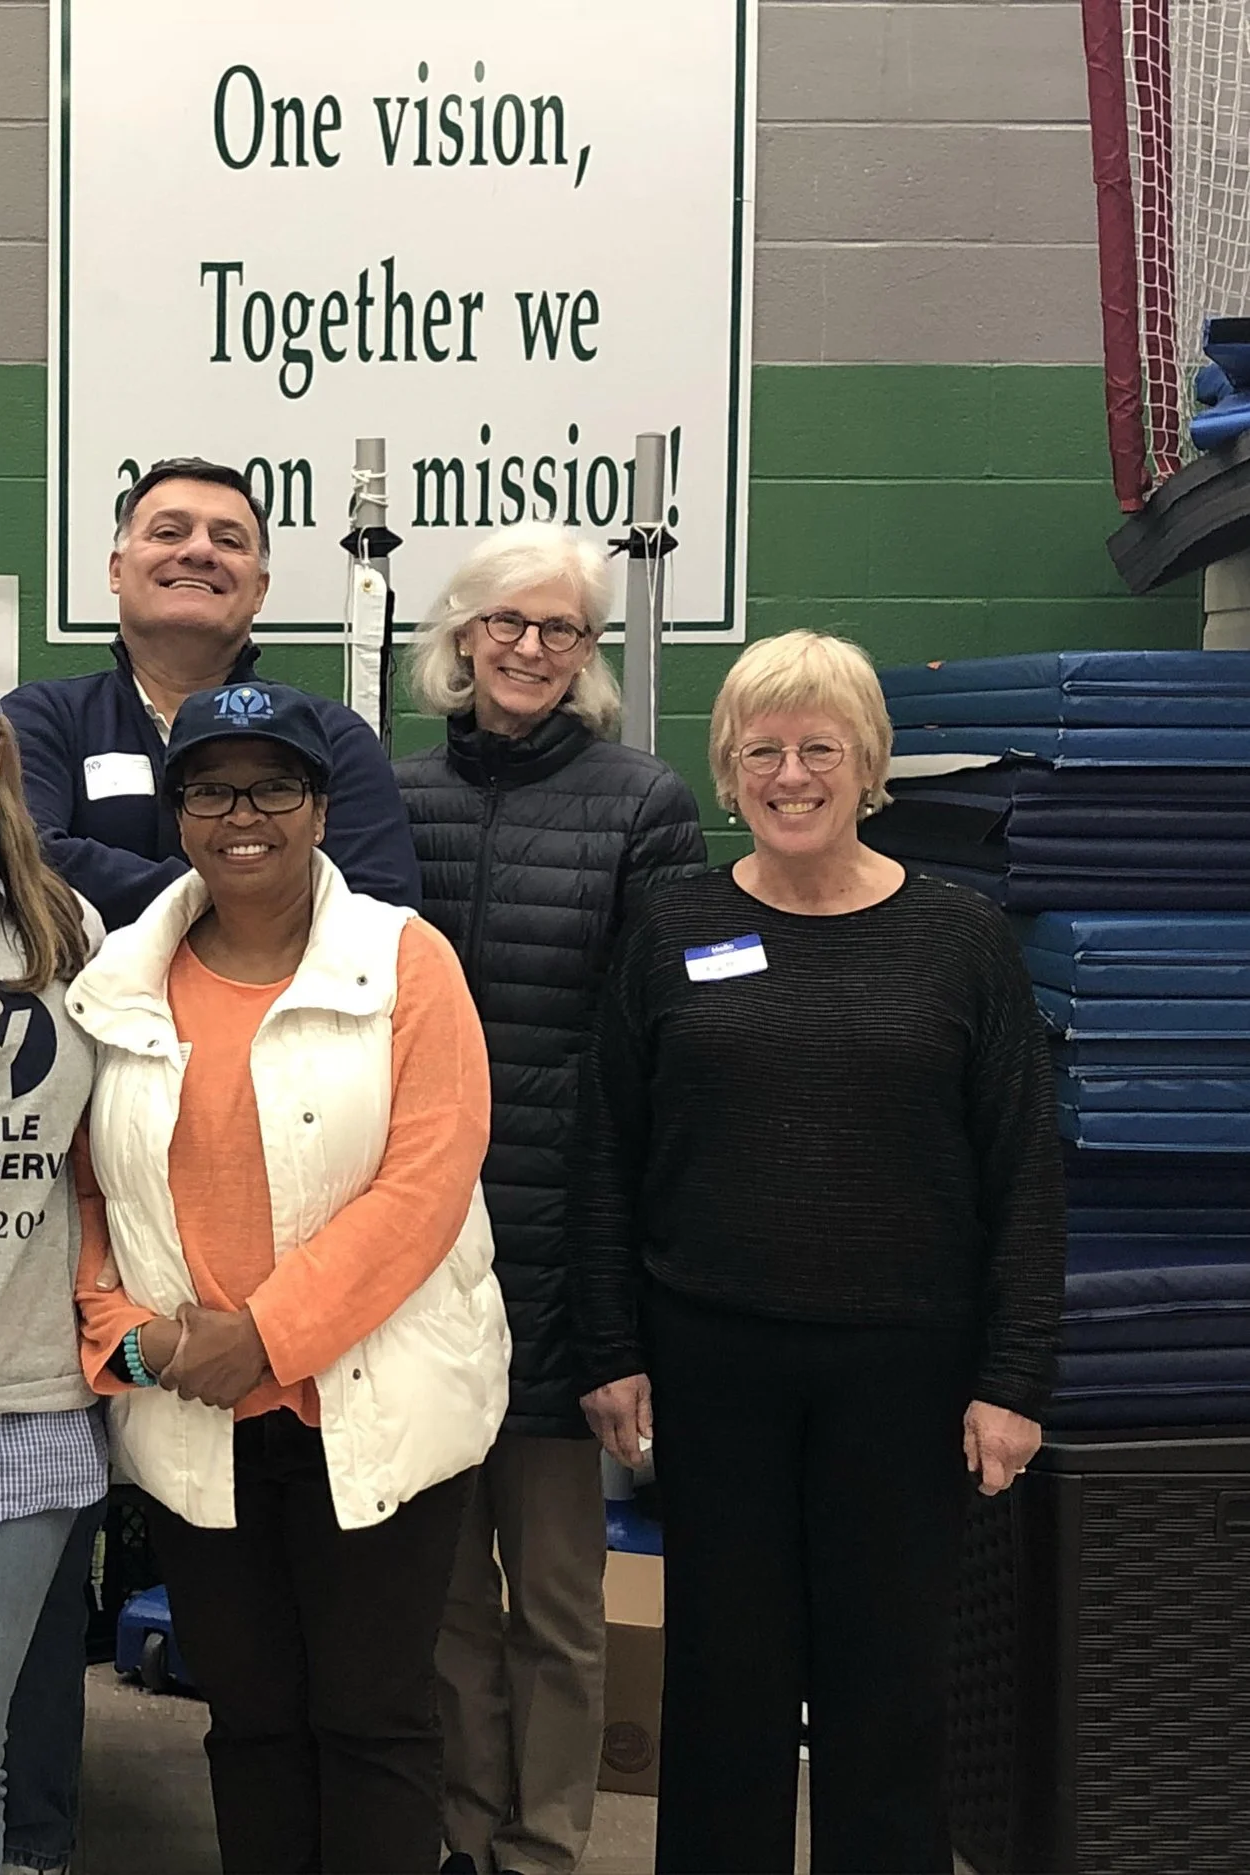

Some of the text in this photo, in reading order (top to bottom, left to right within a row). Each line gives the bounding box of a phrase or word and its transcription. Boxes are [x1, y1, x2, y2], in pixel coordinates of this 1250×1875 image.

[214, 61, 591, 189] One vision,
[200, 257, 600, 400] Together we
[244, 457, 317, 528] on
